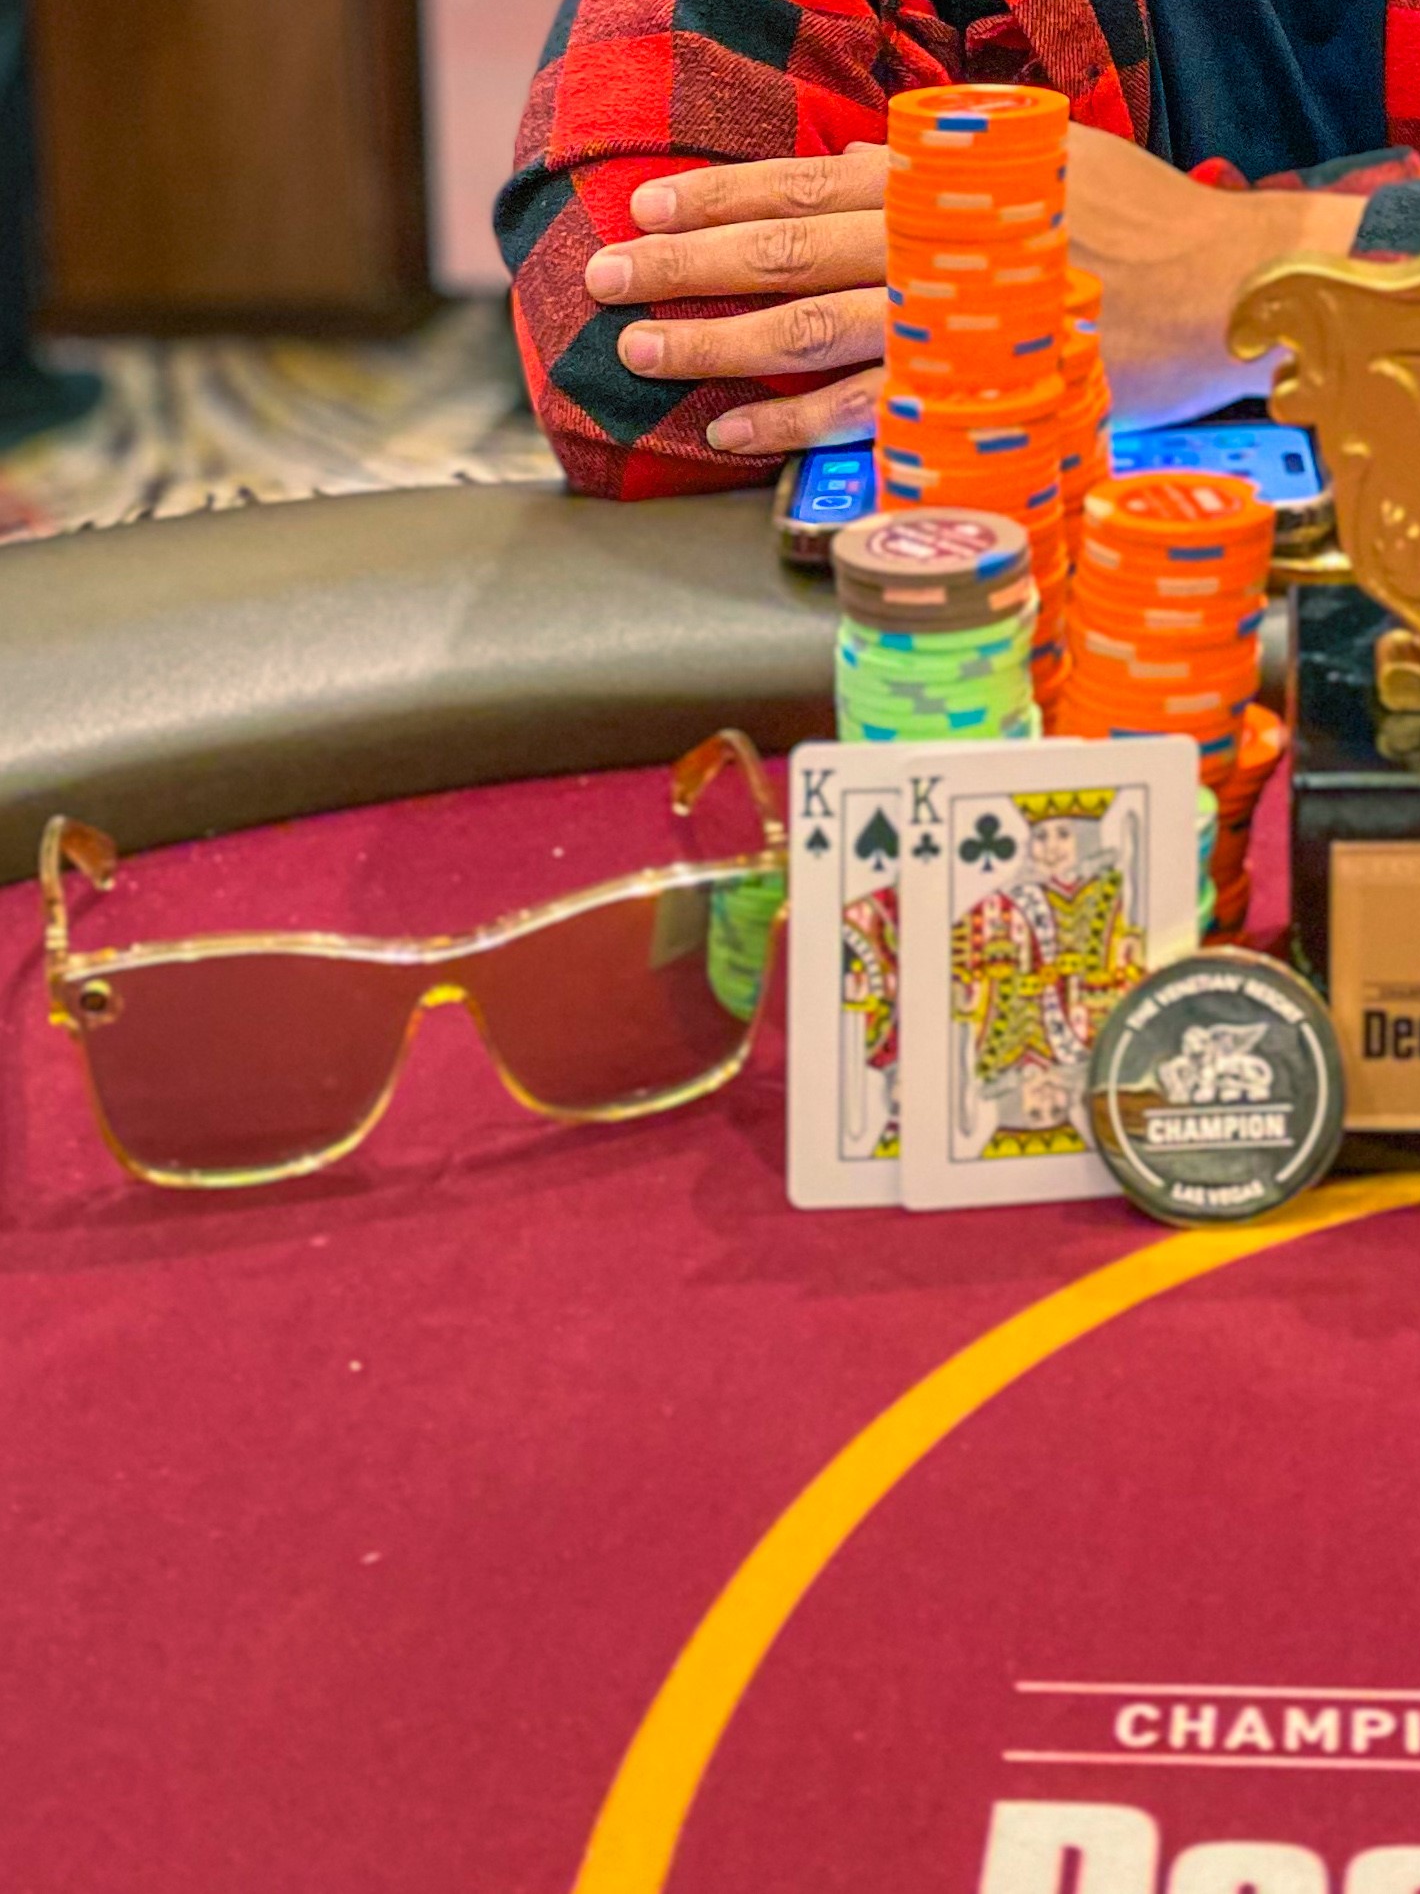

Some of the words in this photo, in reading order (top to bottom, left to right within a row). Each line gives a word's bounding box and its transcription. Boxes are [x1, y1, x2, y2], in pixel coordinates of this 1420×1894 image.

[800, 770, 836, 818] K
[909, 777, 944, 825] K
[1147, 1113, 1286, 1143] CHAMPION
